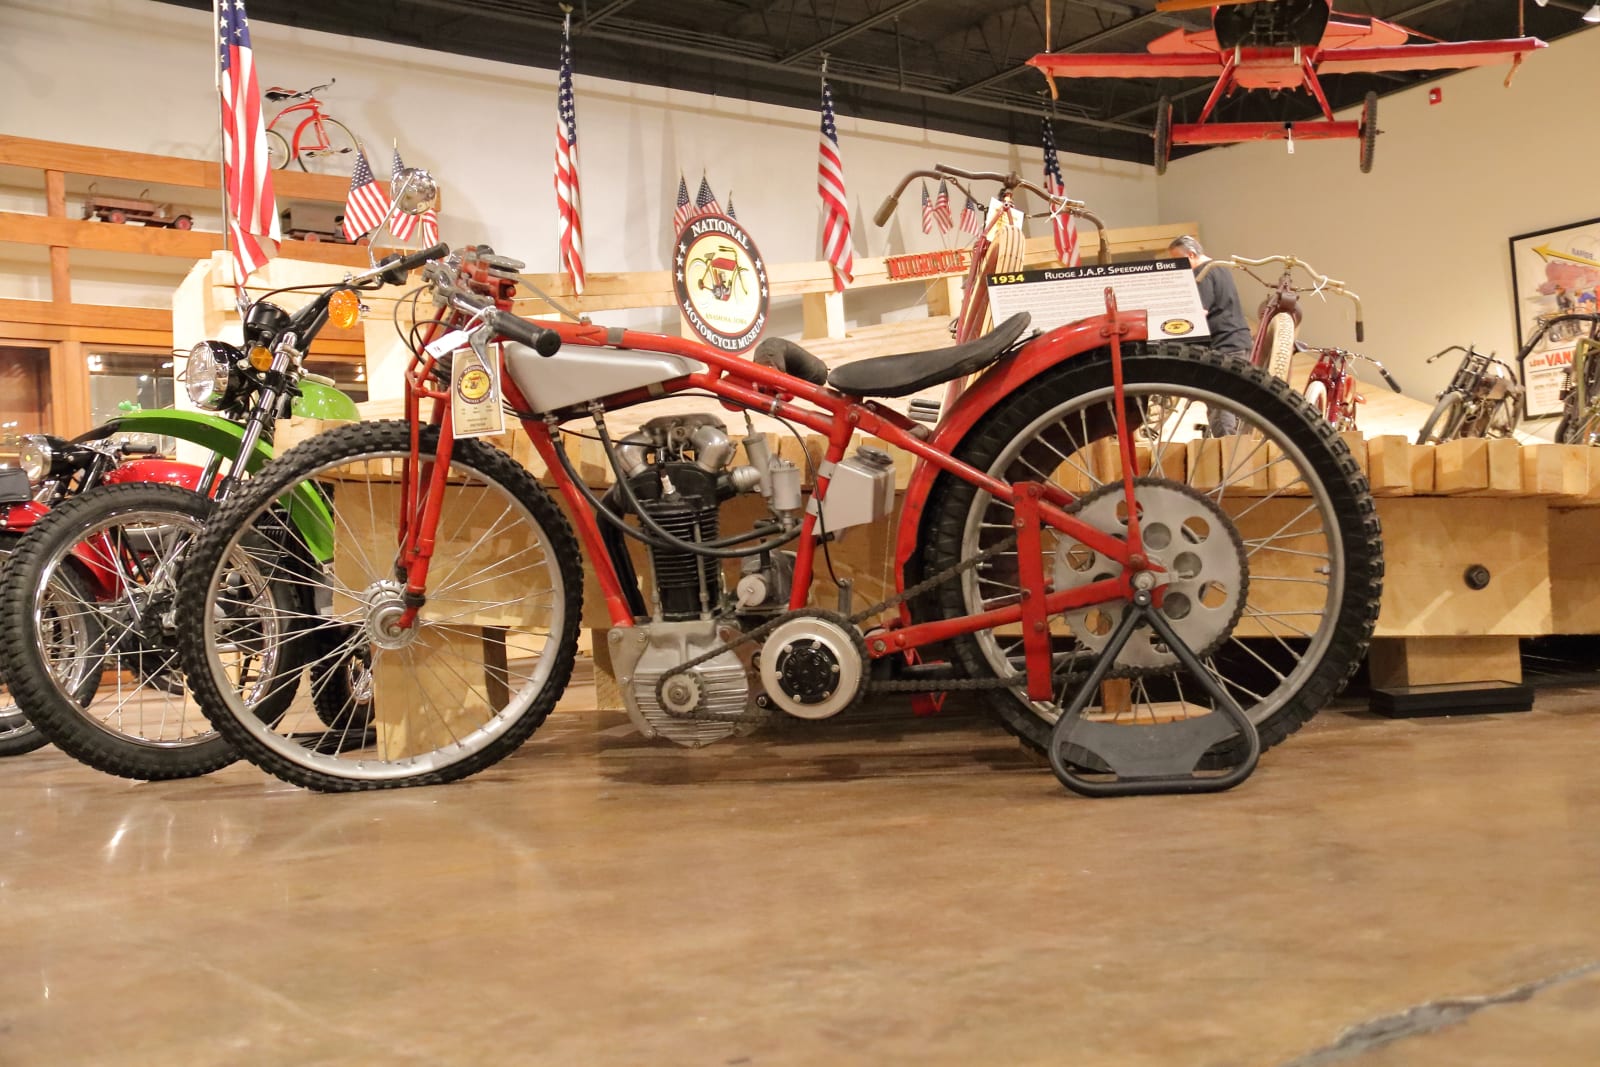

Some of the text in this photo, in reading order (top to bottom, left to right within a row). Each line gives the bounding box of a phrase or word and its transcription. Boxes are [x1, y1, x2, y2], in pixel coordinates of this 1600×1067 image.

[690, 218, 749, 250] NATIONAL
[991, 274, 1025, 285] 1934
[1044, 262, 1177, 280] RUDGE J.A.P. SPEEDWAY BIKE
[683, 300, 765, 350] MOTORCYCLE MUSEUM
